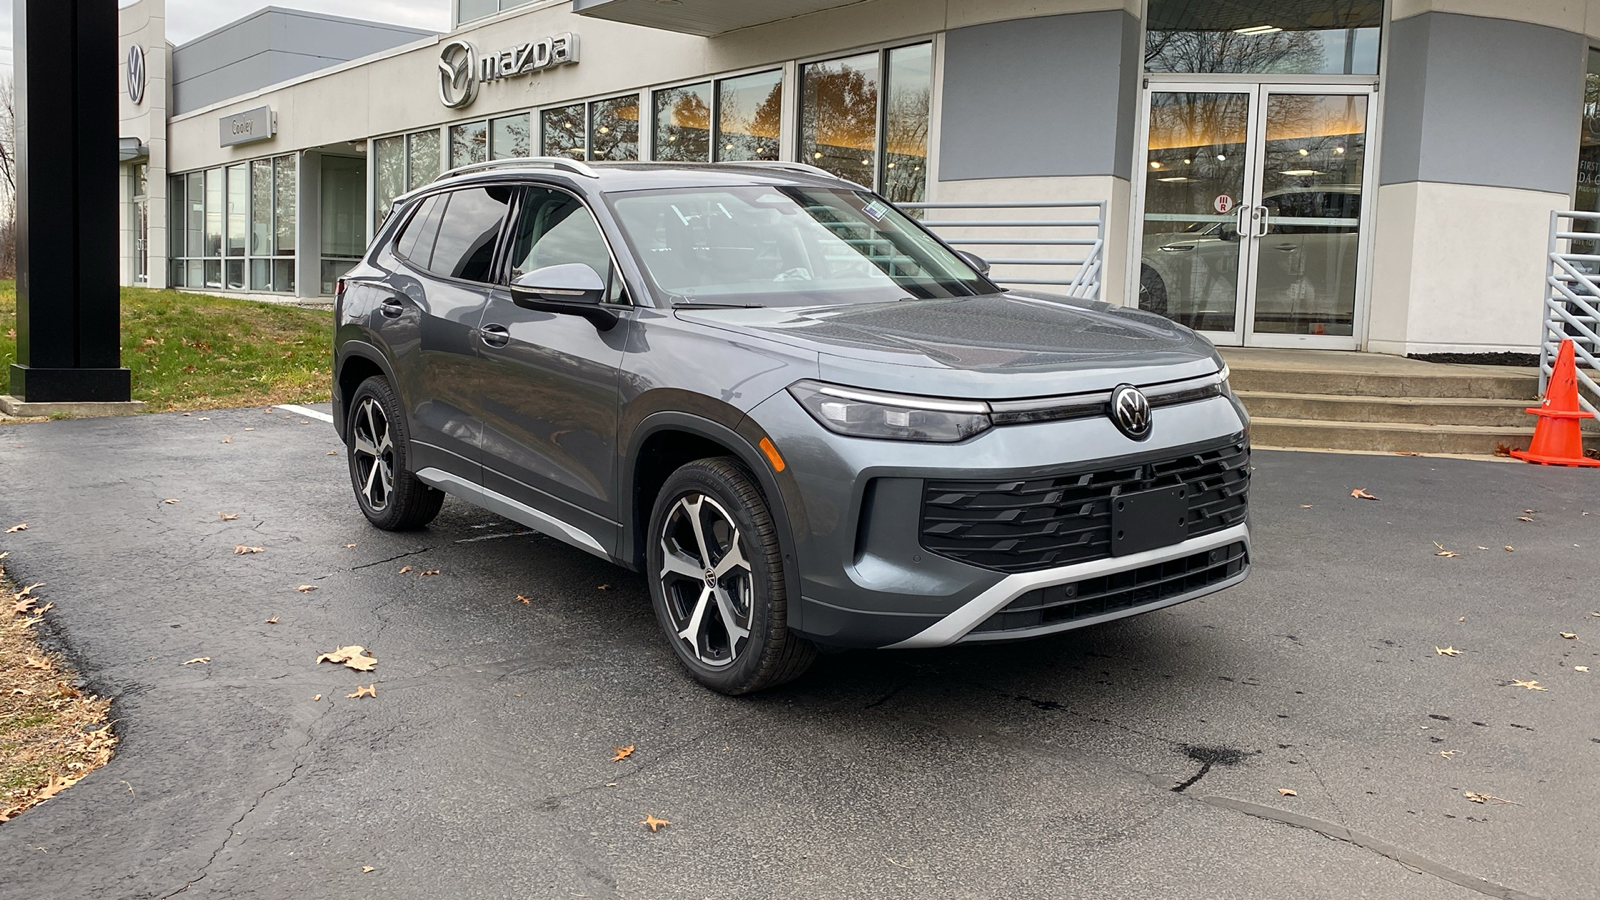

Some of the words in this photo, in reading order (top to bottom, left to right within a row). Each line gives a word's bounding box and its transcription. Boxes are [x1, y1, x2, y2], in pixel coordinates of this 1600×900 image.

[128, 45, 145, 105] VW
[479, 32, 574, 82] mazda
[232, 114, 254, 136] Cooley
[1580, 160, 1600, 172] FIRST
[1117, 387, 1151, 435] VW
